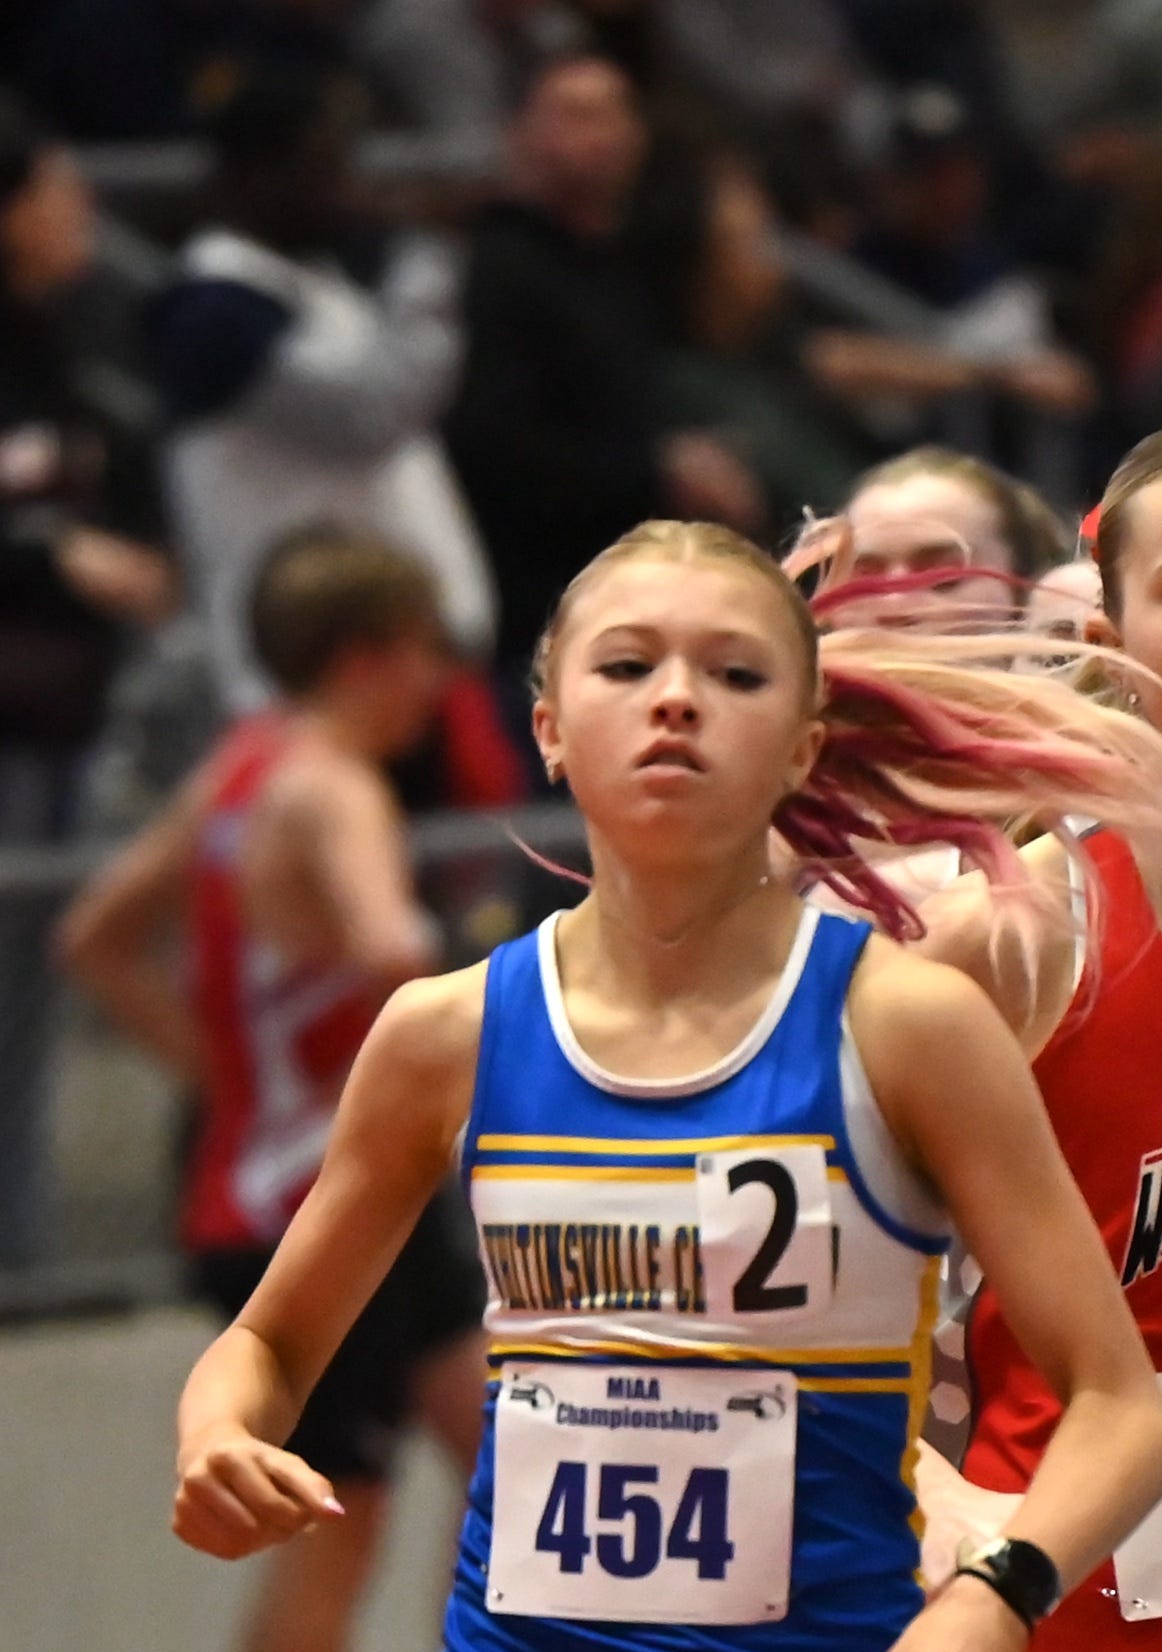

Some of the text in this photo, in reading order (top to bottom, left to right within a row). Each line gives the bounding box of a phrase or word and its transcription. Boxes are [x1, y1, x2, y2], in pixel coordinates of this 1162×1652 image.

[727, 1158, 808, 1313] 2
[556, 1402, 719, 1433] Championships
[606, 1376, 660, 1401] MIAA
[534, 1461, 735, 1581] 454
